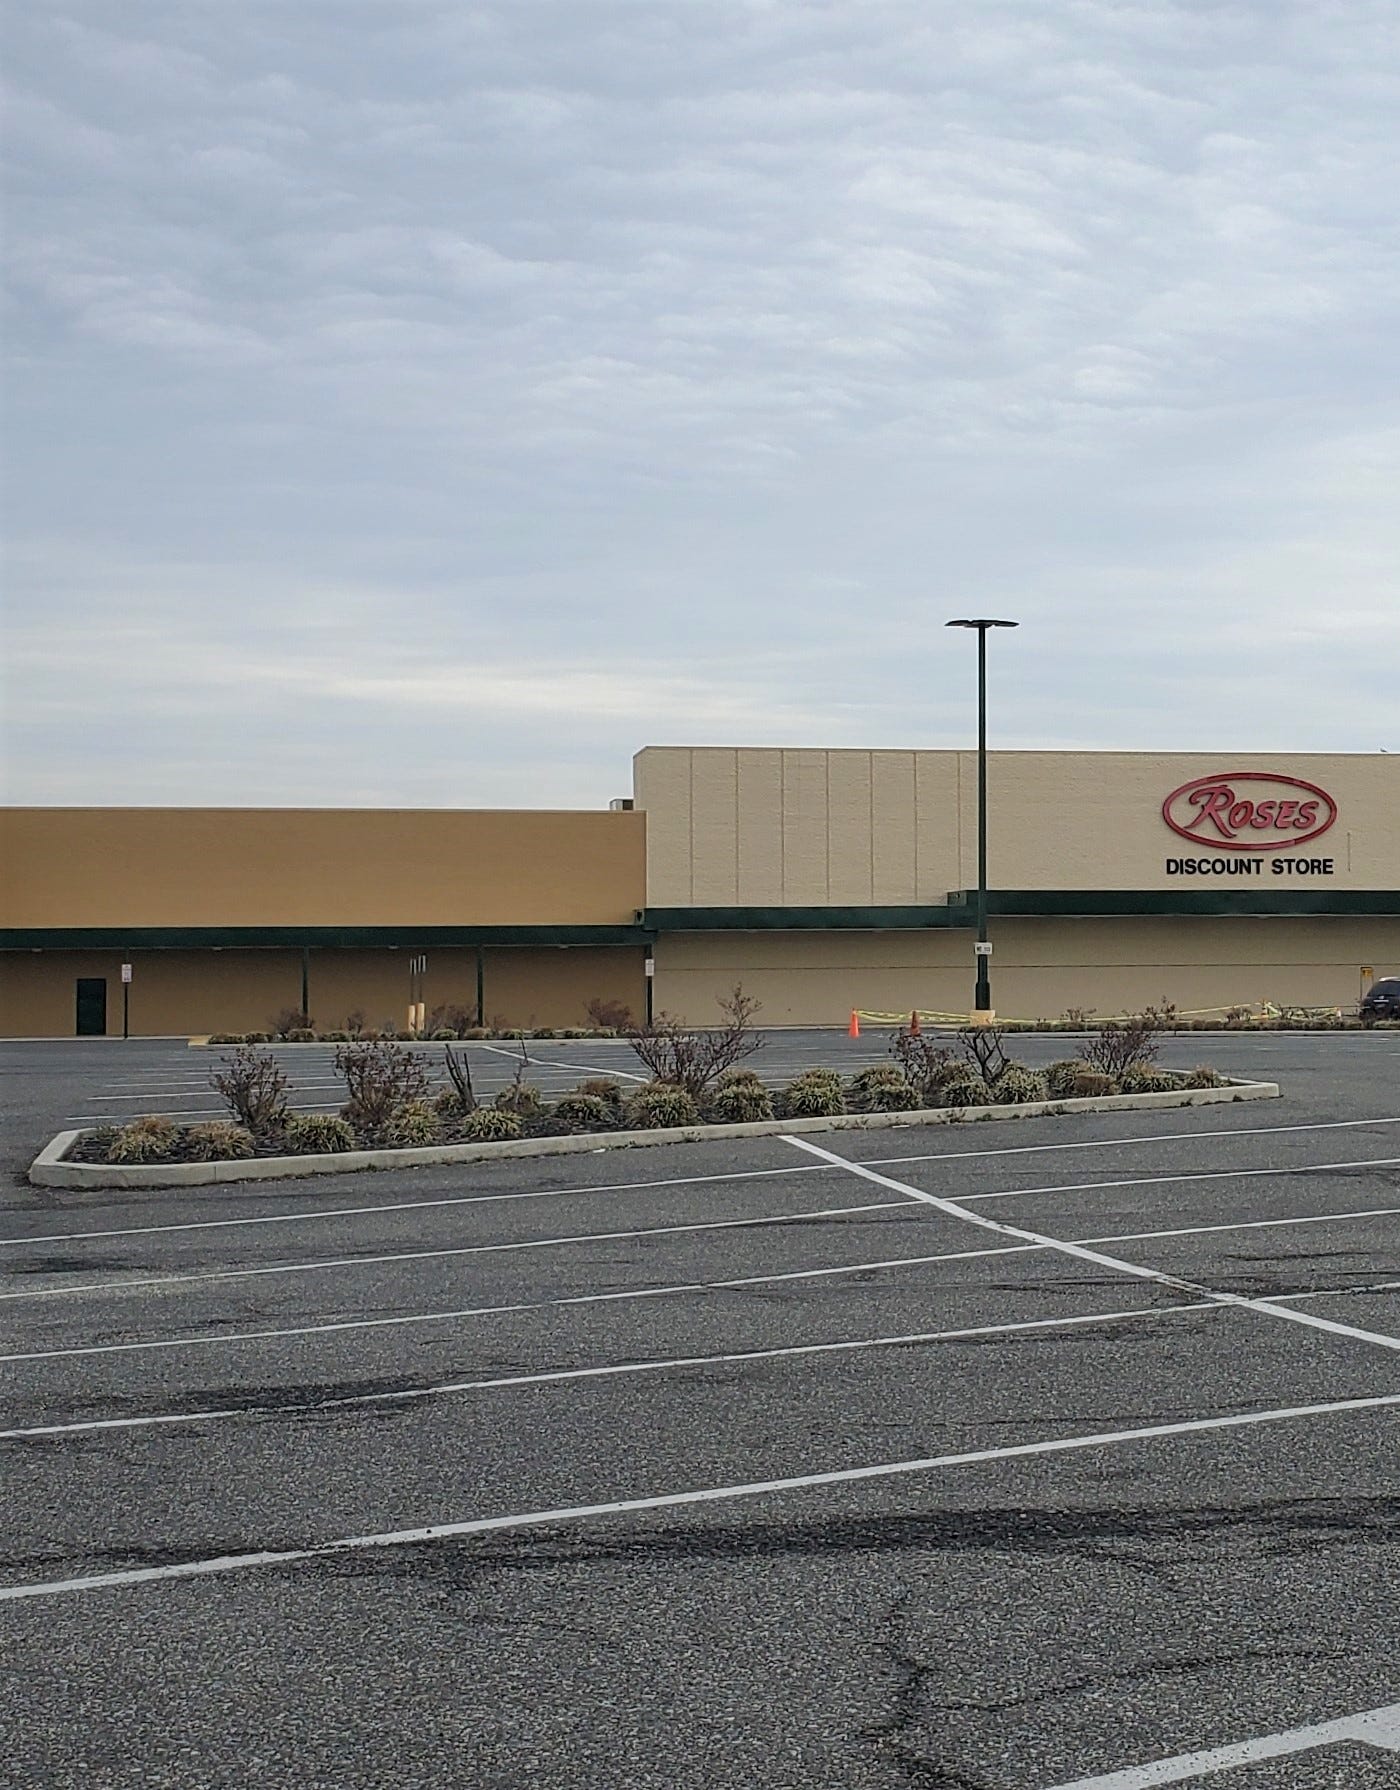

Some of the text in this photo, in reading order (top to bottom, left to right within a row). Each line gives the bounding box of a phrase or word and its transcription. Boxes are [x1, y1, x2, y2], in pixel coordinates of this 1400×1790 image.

[1183, 784, 1320, 839] ROSES
[1166, 858, 1334, 875] DISCOUNT STORE
